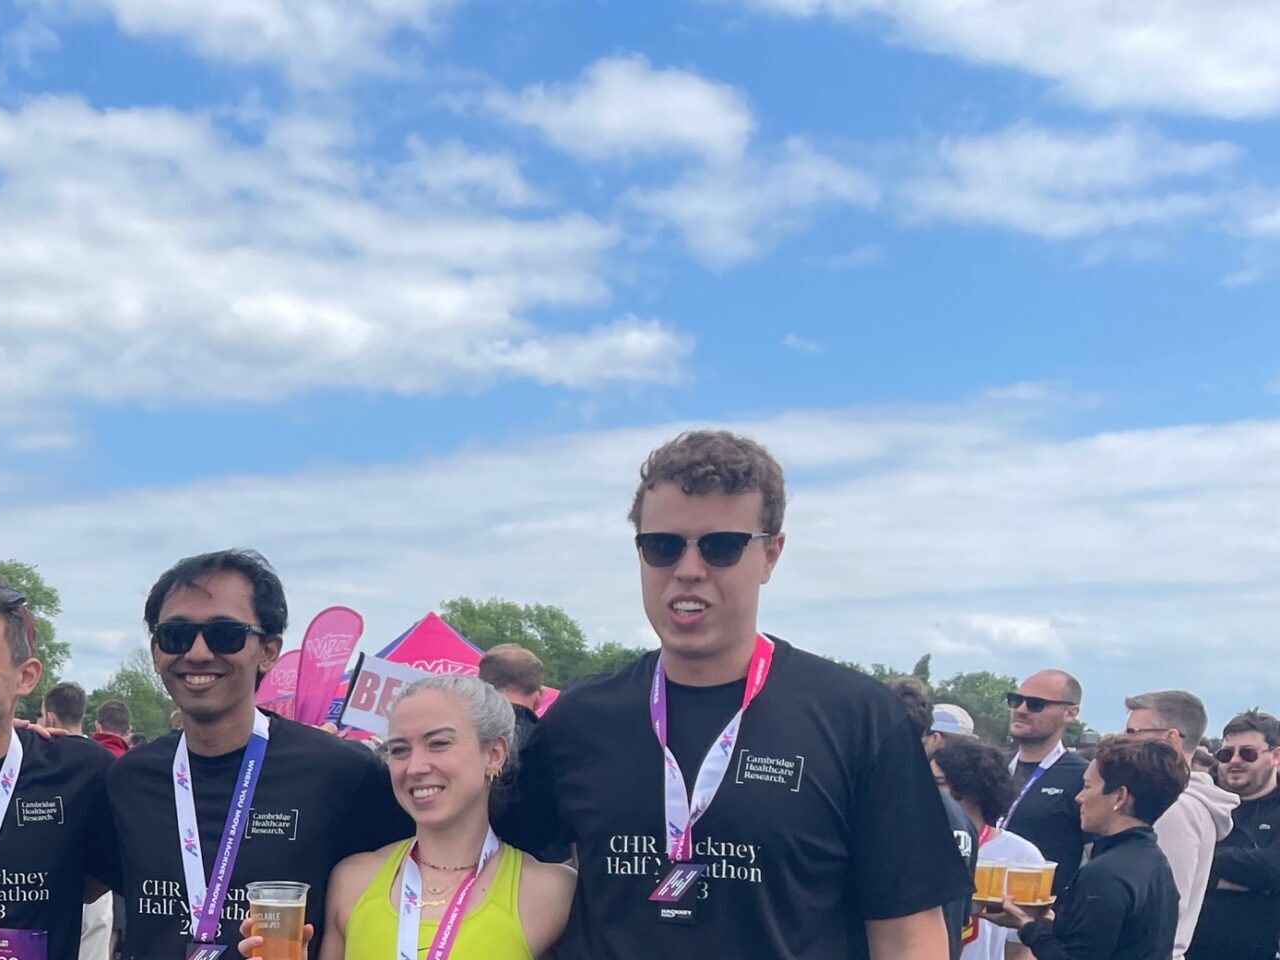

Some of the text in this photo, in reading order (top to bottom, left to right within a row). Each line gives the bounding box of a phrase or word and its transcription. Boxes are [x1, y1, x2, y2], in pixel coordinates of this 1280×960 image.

[745, 763, 794, 776] Healthcare
[746, 755, 795, 768] Cambridge
[744, 771, 787, 784] Research.
[251, 819, 291, 828] Healthcare
[252, 812, 291, 821] Cambridge
[207, 760, 255, 915] WHEN YOU MOVE HACKNEY MOVES
[610, 835, 762, 864] CHR ckney
[606, 856, 651, 875] Half
[142, 880, 182, 897] CHR
[138, 898, 177, 915] Half
[439, 906, 460, 950] HACKNEY
